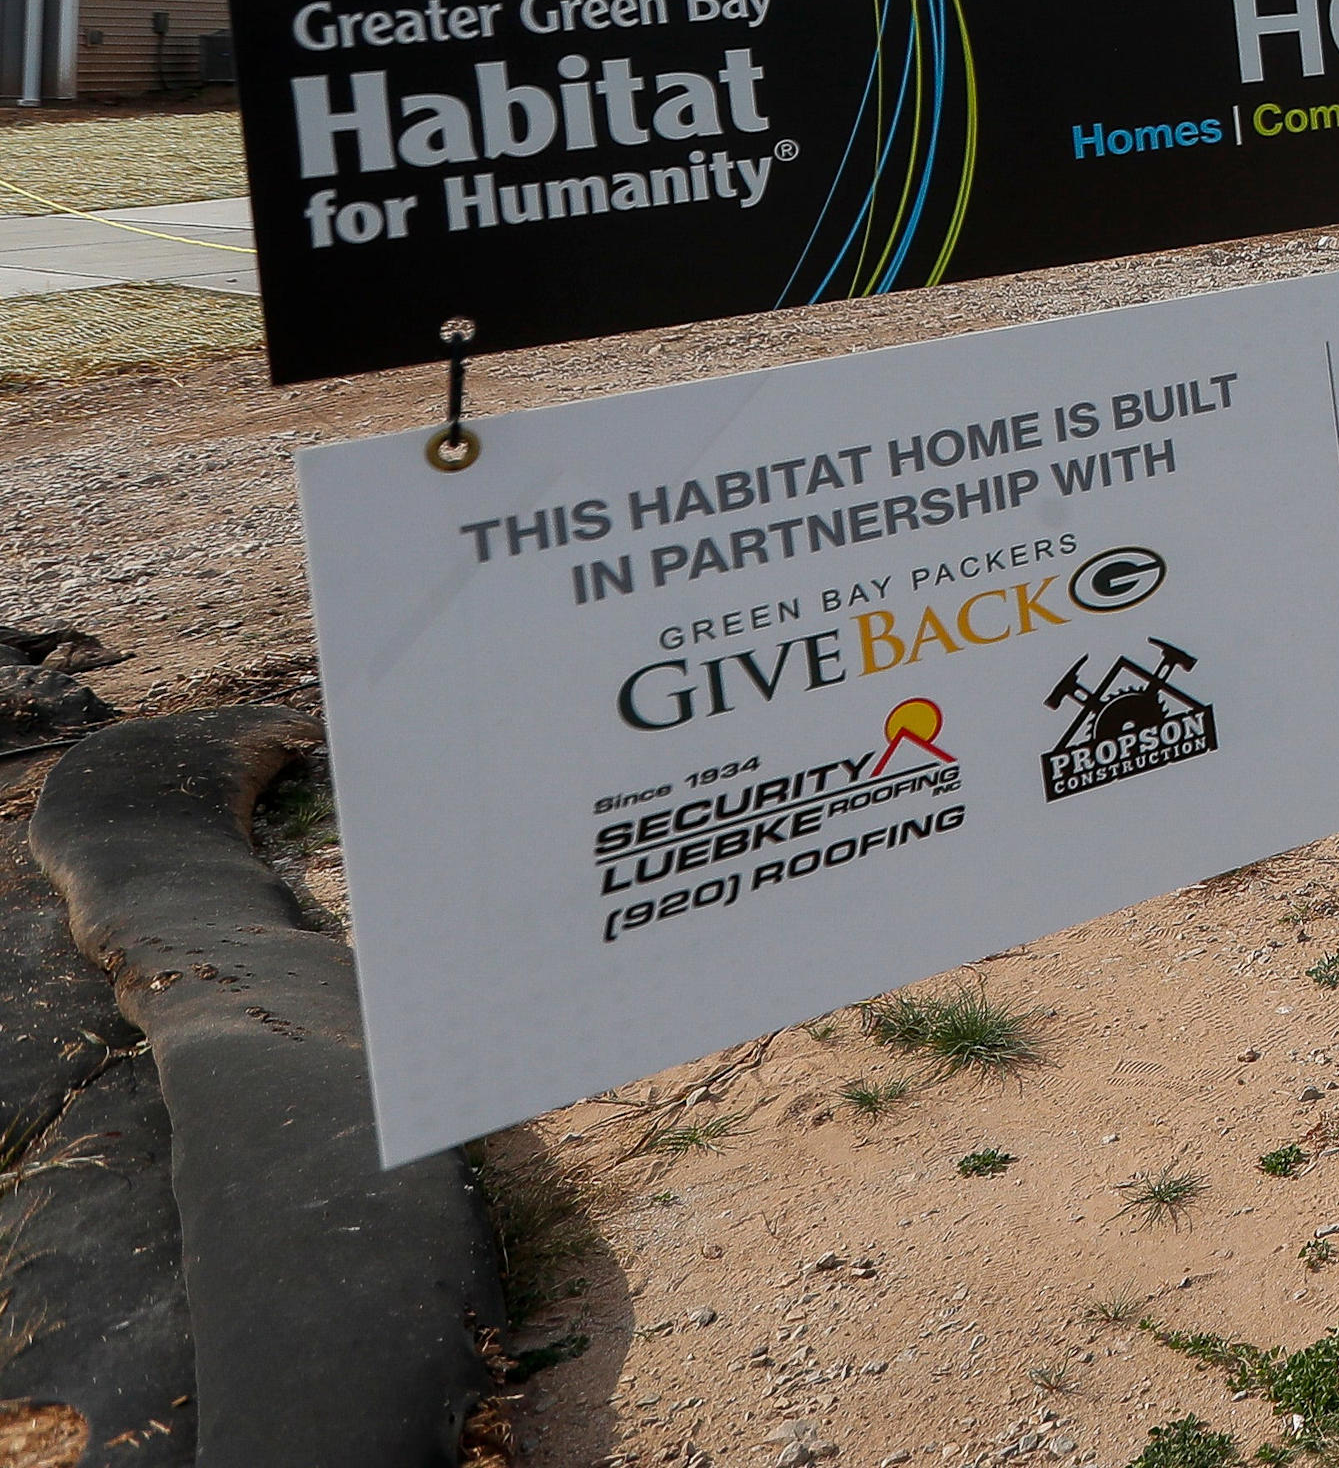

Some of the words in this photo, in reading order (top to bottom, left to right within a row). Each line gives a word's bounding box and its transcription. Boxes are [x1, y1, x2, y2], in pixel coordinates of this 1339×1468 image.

[292, 0, 504, 51] Greater
[291, 48, 770, 178] Habitat
[1072, 115, 1223, 160] Homes
[305, 189, 417, 249] for
[461, 498, 613, 563] THIS
[628, 444, 873, 531] HABITAT
[888, 412, 1044, 478] HOME
[1055, 401, 1101, 443] IS
[1111, 372, 1239, 434] BUILT
[570, 555, 634, 606] IN
[650, 467, 1040, 590] PARTNERSHIP
[1050, 438, 1176, 496] WITH
[659, 597, 801, 651] GREEN
[822, 575, 893, 614] BAY
[911, 532, 1079, 591] PACKERS
[593, 785, 672, 815] Since
[685, 755, 762, 789] 1934
[932, 781, 962, 797] INC
[1049, 711, 1207, 781] PROPSON
[1054, 736, 1207, 794] CONSTRUCTION
[595, 750, 876, 857] SECURITY
[601, 805, 824, 896] LUEBKE
[827, 765, 960, 818] ROOFING
[603, 873, 744, 943] (920)
[751, 804, 966, 892] ROOFING
